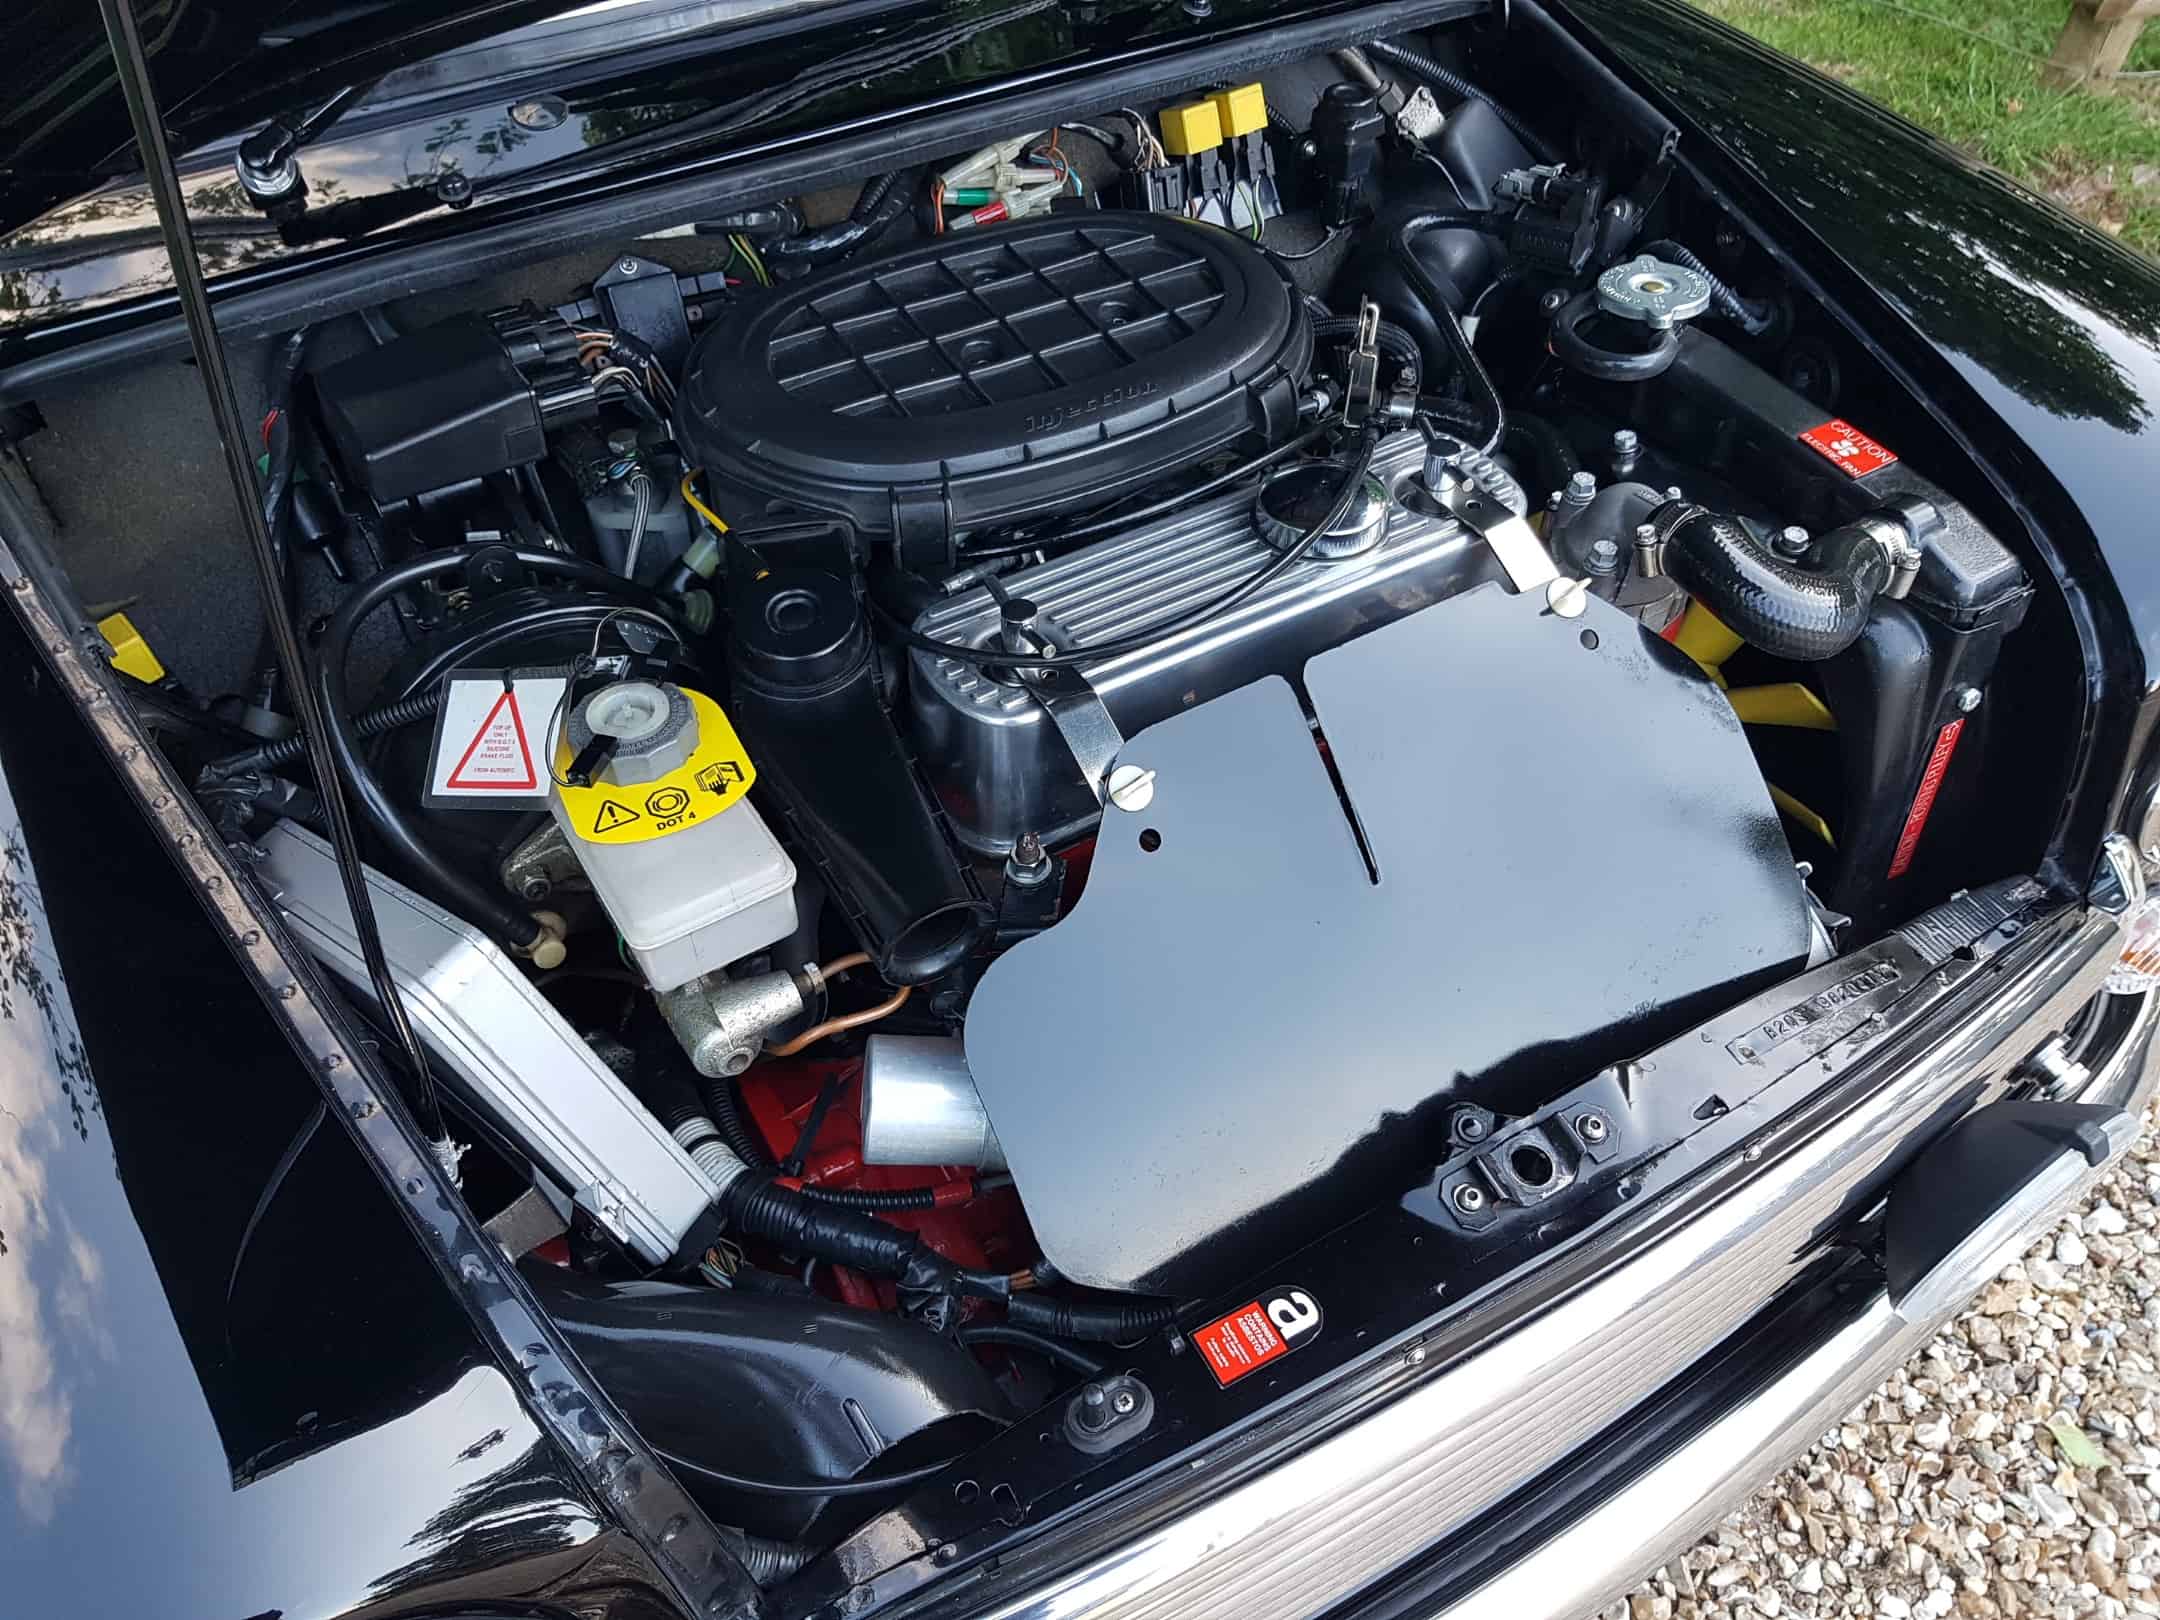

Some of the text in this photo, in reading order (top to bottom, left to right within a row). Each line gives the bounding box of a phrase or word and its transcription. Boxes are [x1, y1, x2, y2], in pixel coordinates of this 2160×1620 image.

[1830, 421, 1893, 463] CAUTION
[656, 811, 697, 831] DOT 4
[1236, 1317, 1265, 1357] ASBESTOS
[1244, 1313, 1272, 1352] CONTAINS
[1251, 1310, 1279, 1347] WARNING
